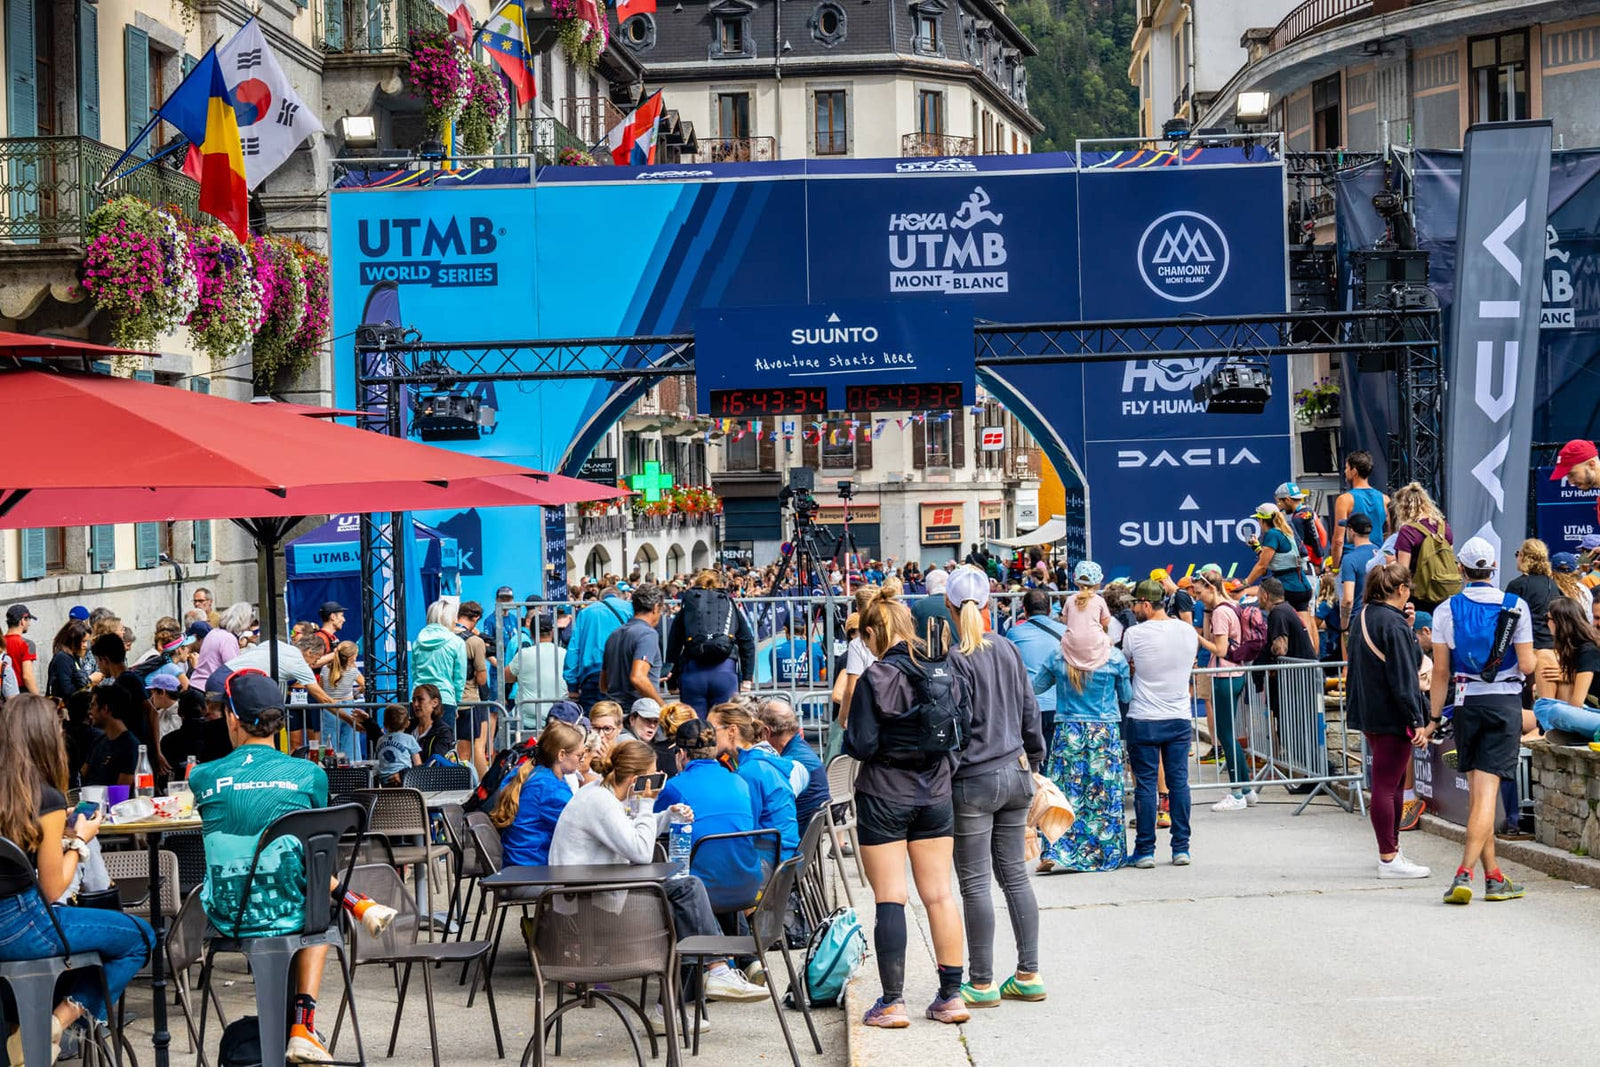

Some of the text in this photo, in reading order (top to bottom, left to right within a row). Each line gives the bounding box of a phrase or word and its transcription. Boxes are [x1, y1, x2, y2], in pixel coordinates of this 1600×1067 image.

[888, 213, 948, 231] HOKA
[358, 215, 498, 258] UTMB
[888, 231, 1008, 269] UTMB
[365, 265, 493, 284] WORLD SERIES
[1158, 265, 1211, 277] CHAMONIX
[791, 326, 879, 345] SUUNTO
[722, 390, 826, 416] 16:43:34
[1122, 400, 1150, 416] FLY
[1118, 447, 1261, 468] DACIA
[1561, 490, 1573, 498] FLY
[1119, 518, 1262, 547] SUUNTO
[1563, 525, 1594, 535] UTMB
[1498, 617, 1514, 652] SALOMON
[201, 776, 298, 798] La Pastourelle
